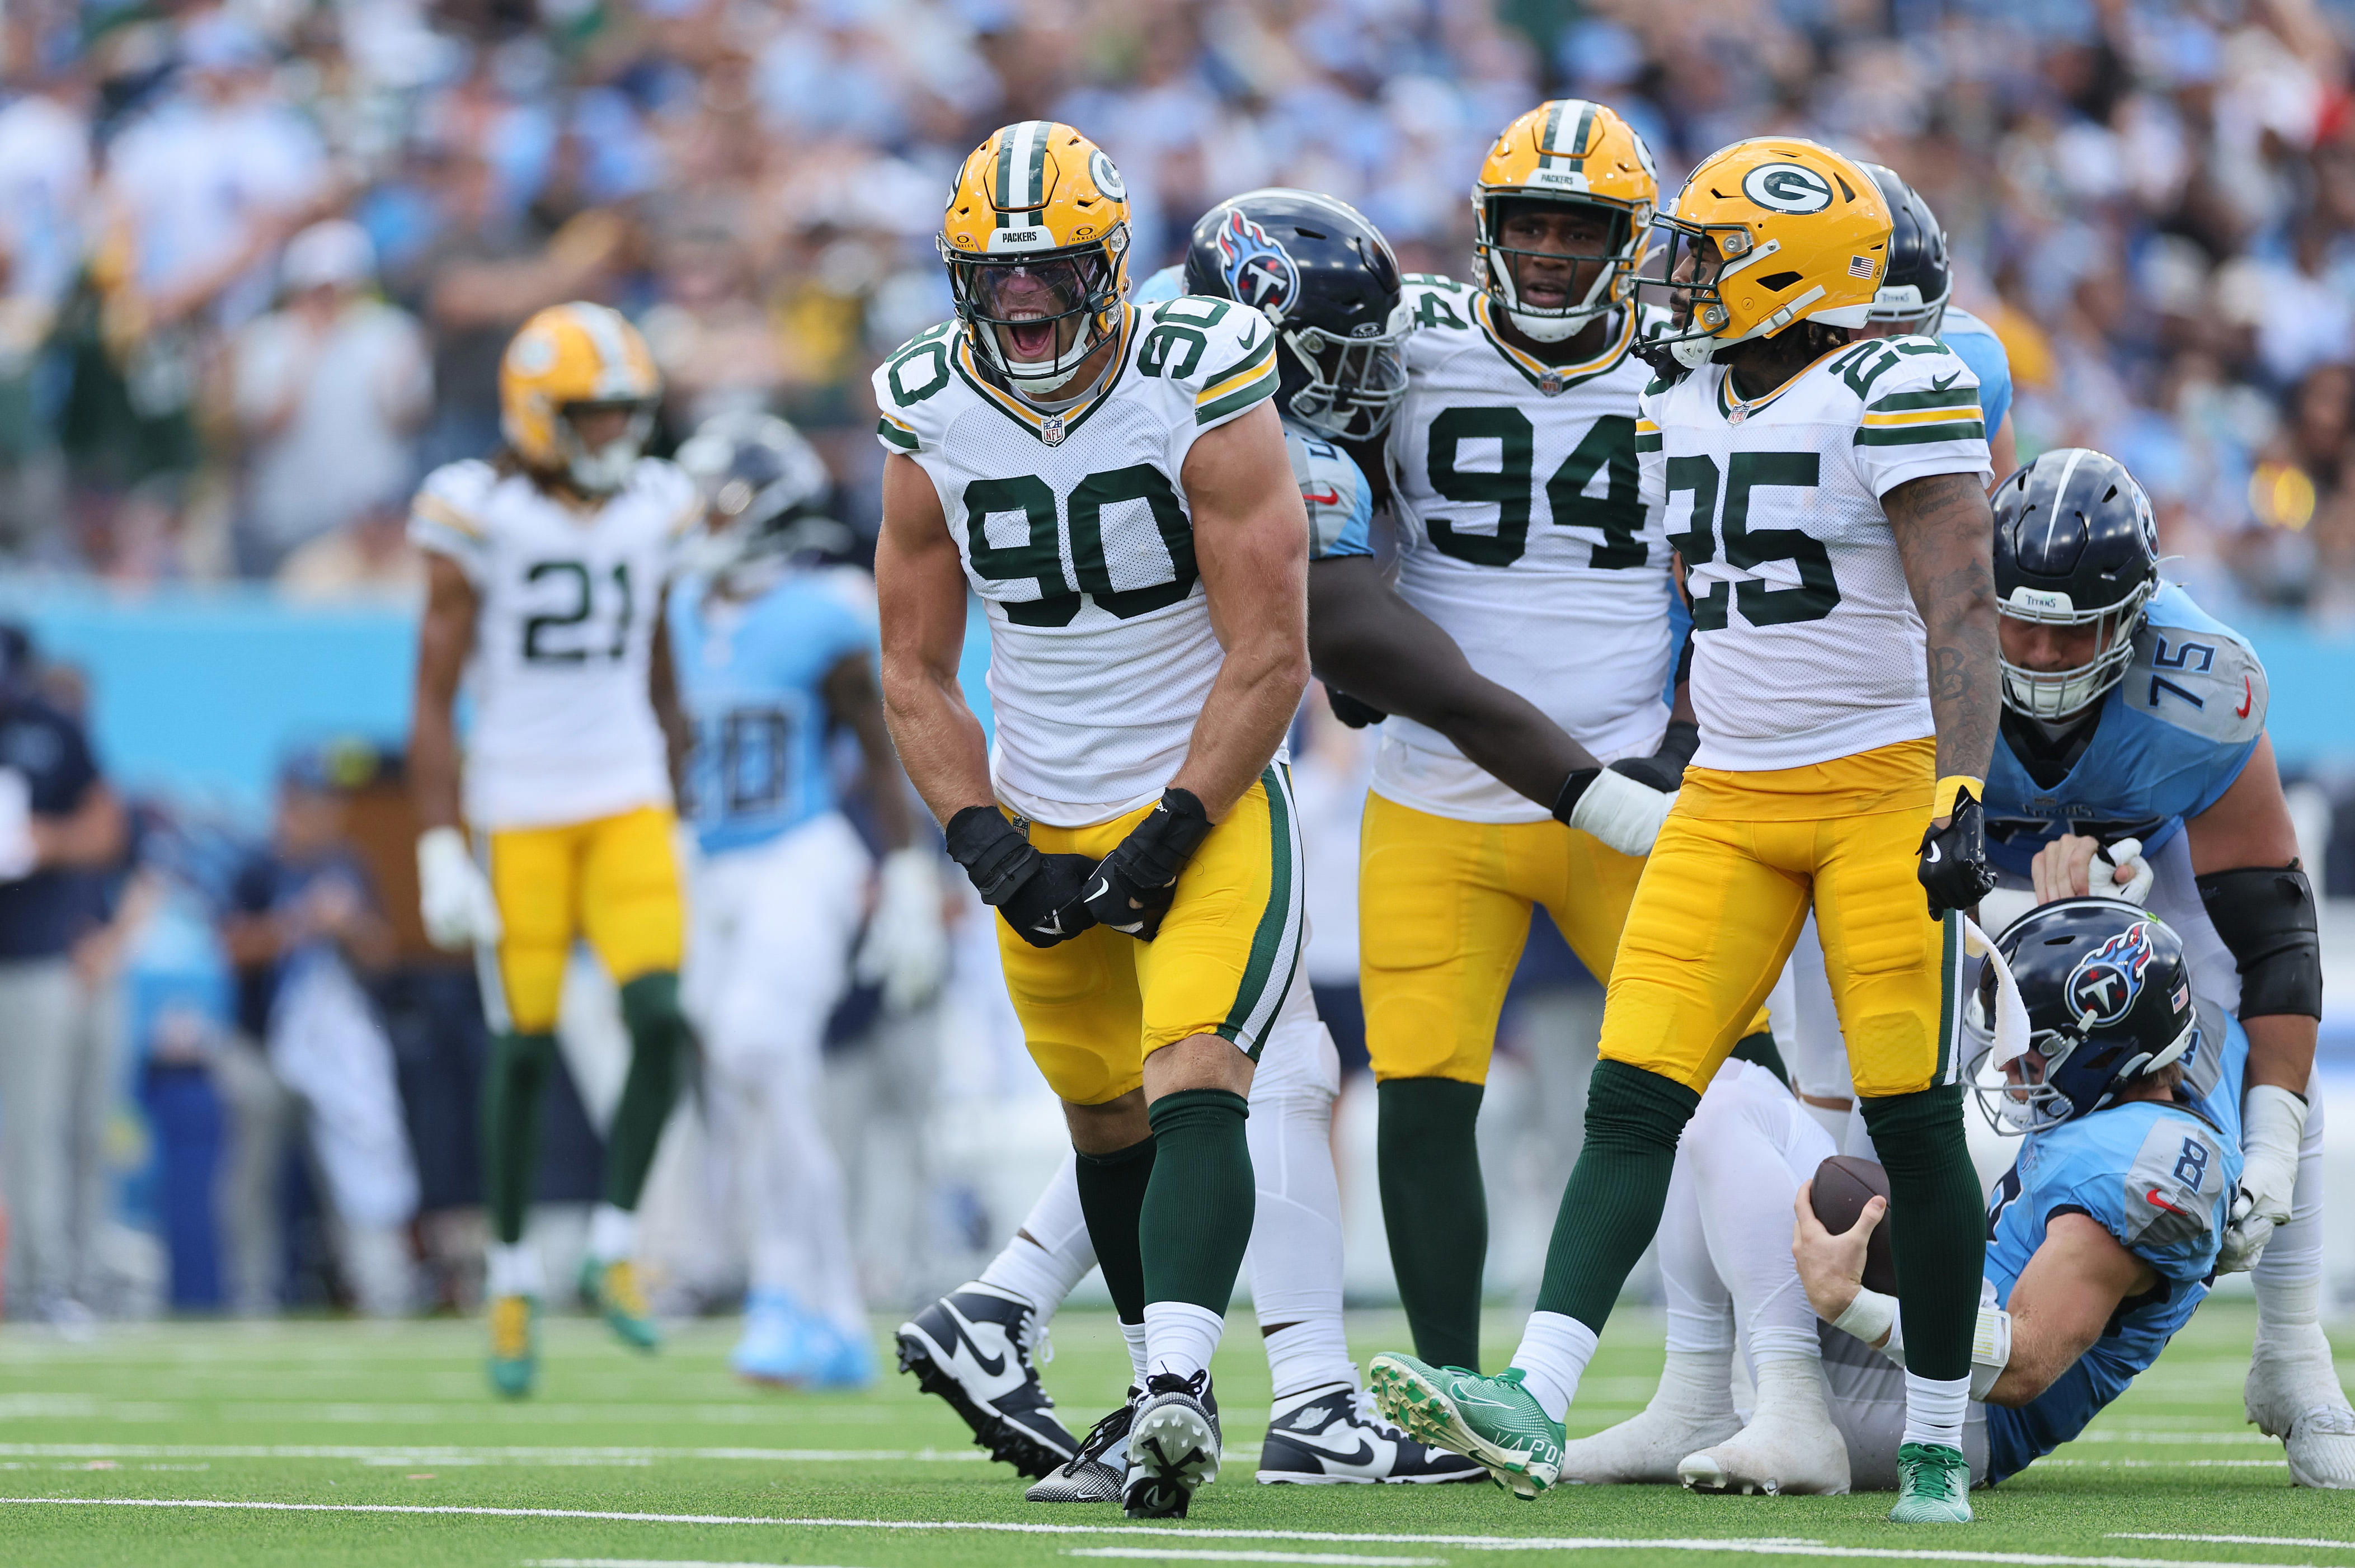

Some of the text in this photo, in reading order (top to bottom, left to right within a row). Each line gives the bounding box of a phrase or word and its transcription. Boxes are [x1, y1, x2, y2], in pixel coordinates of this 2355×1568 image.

[1745, 163, 1830, 212] G
[1002, 231, 1037, 243] PACKERS
[1247, 262, 1287, 306] T
[1136, 295, 1231, 379] 90
[1046, 428, 1061, 441] NFL
[1729, 412, 1744, 423] NFL
[1425, 407, 1649, 569] 94
[962, 463, 1201, 627] 90
[1666, 452, 1841, 632] 25
[525, 559, 633, 661] 21
[2025, 594, 2057, 608] TITANS
[2147, 632, 2218, 712] 75
[2077, 972, 2118, 1014] T
[2172, 1134, 2210, 1194] 8
[1494, 1431, 1565, 1471] VAPOR
